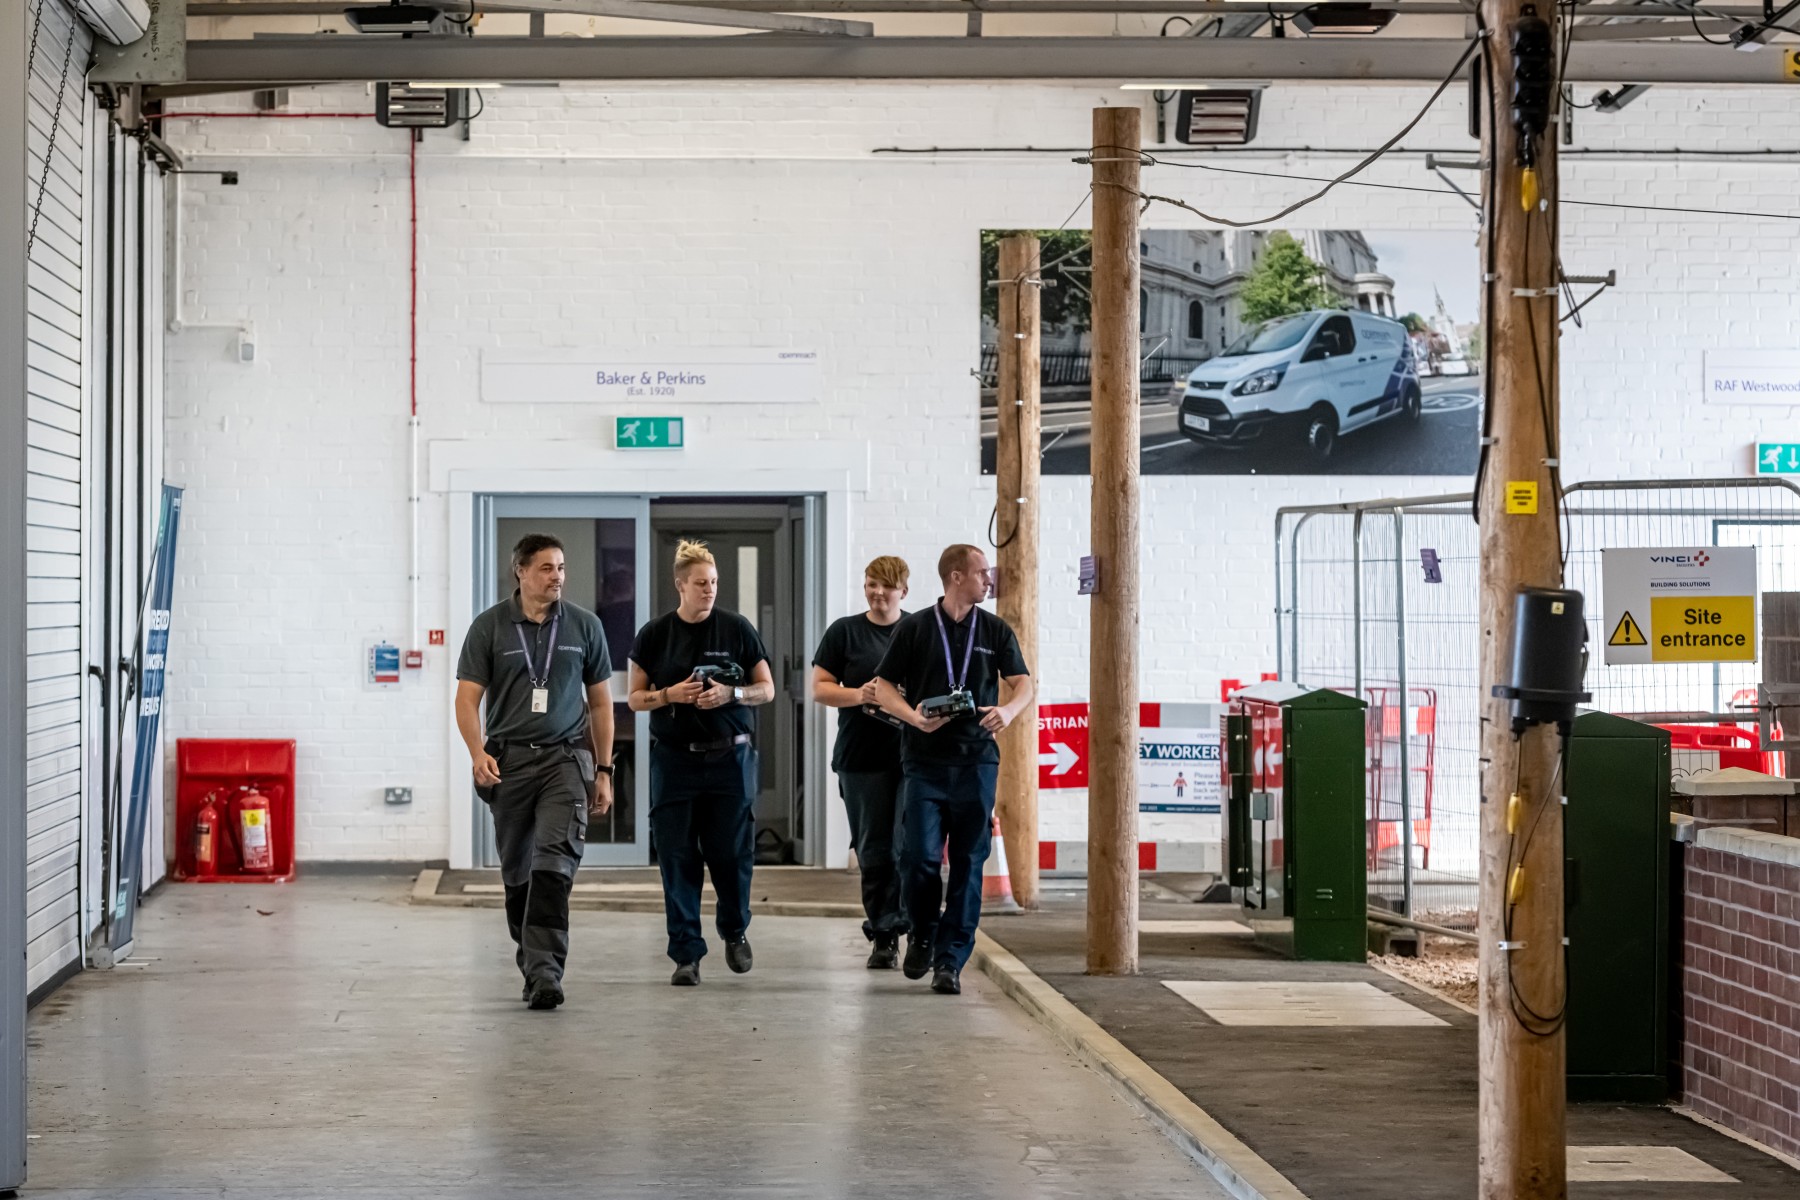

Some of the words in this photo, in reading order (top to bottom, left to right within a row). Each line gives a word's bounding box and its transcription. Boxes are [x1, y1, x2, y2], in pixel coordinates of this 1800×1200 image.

[596, 371, 636, 385] Baker
[640, 371, 652, 385] &
[657, 371, 706, 385] Perkins
[627, 386, 646, 396] (Est.
[650, 386, 675, 396] 1920)
[1714, 380, 1738, 392] RAF
[1741, 379, 1800, 392] Westwood
[1650, 555, 1691, 563] VINCI
[1684, 608, 1722, 625] Site
[1660, 632, 1746, 647] entrance
[1157, 745, 1220, 759] WORKER
